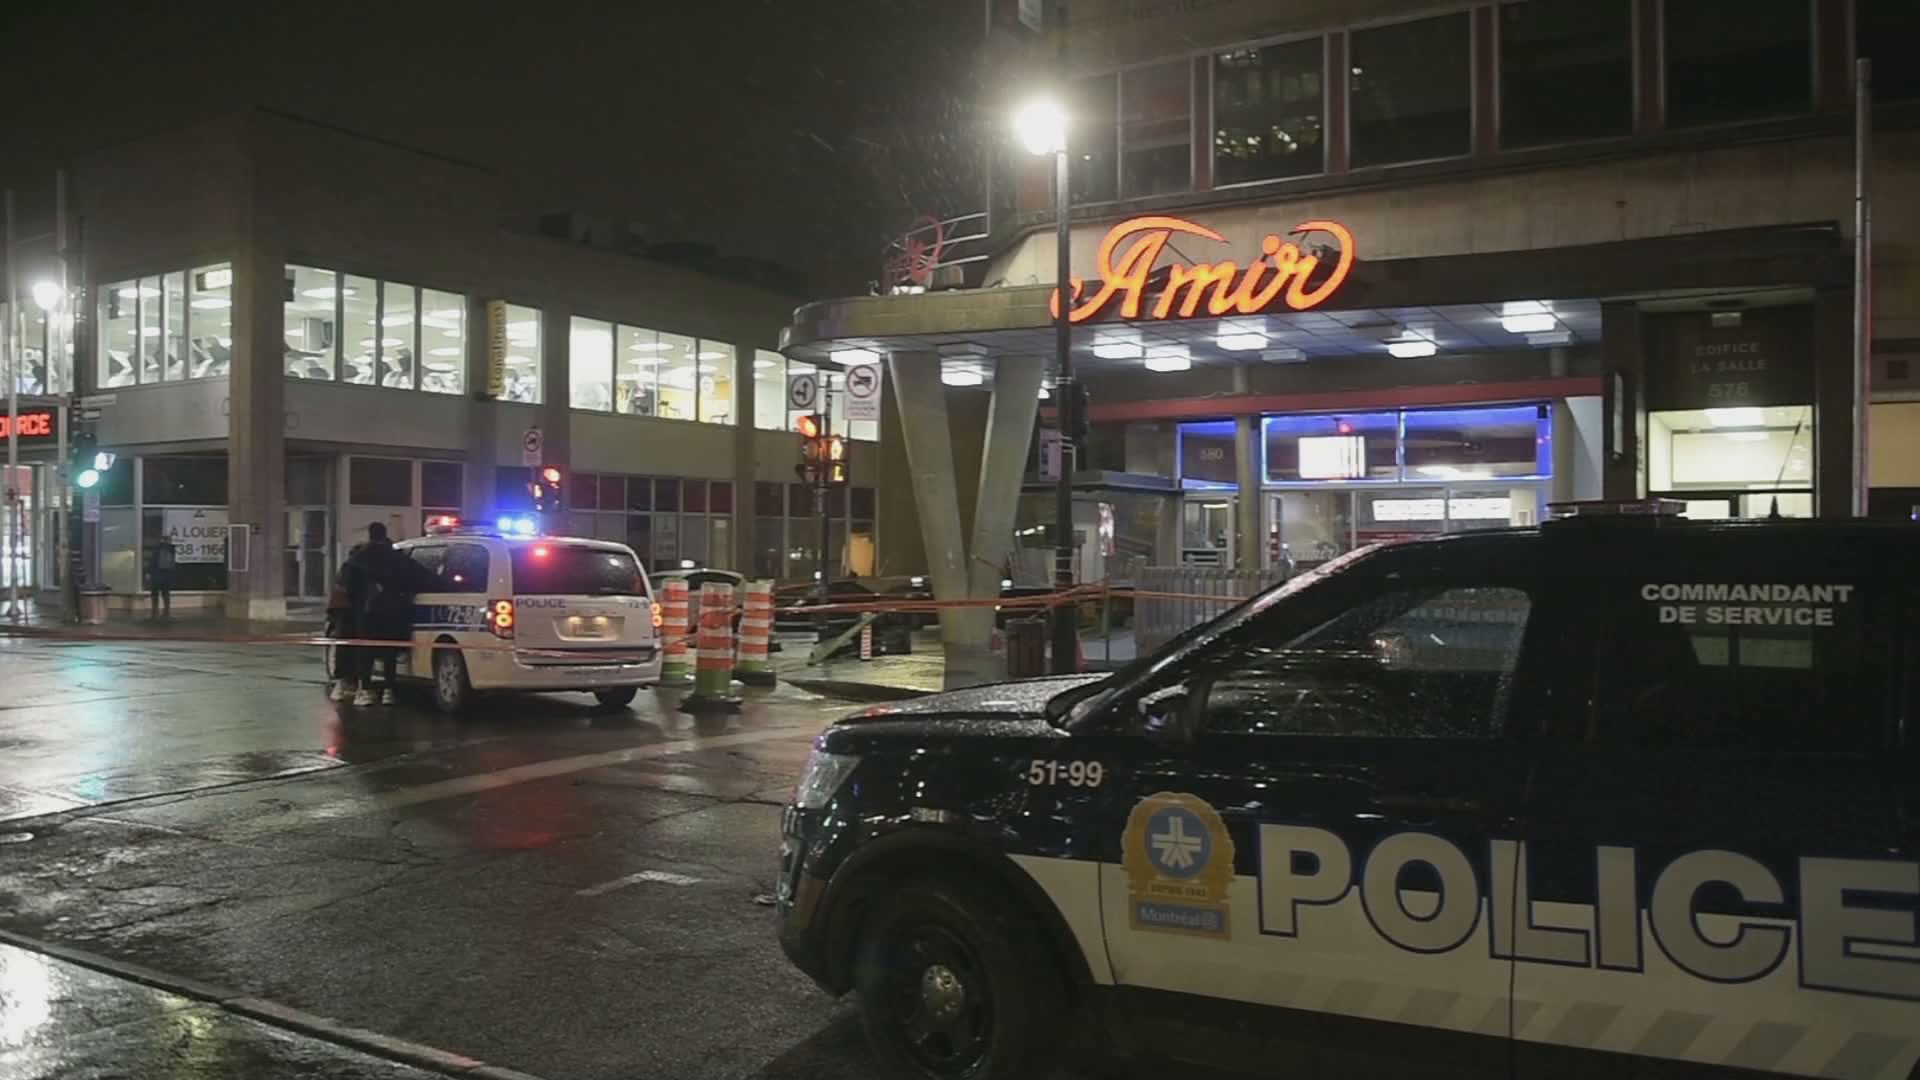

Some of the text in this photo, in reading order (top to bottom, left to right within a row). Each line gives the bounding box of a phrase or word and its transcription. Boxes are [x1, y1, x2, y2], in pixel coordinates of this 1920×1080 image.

[1050, 215, 1355, 322] Amir
[1717, 359, 1768, 371] SALLE
[516, 598, 567, 608] POLICE
[1641, 584, 1854, 602] COMMANDANT
[1659, 606, 1834, 626] DE SERVICE
[1028, 760, 1103, 787] 51-99
[1140, 905, 1201, 927] Montréal
[1257, 822, 1920, 1003] POLICE
